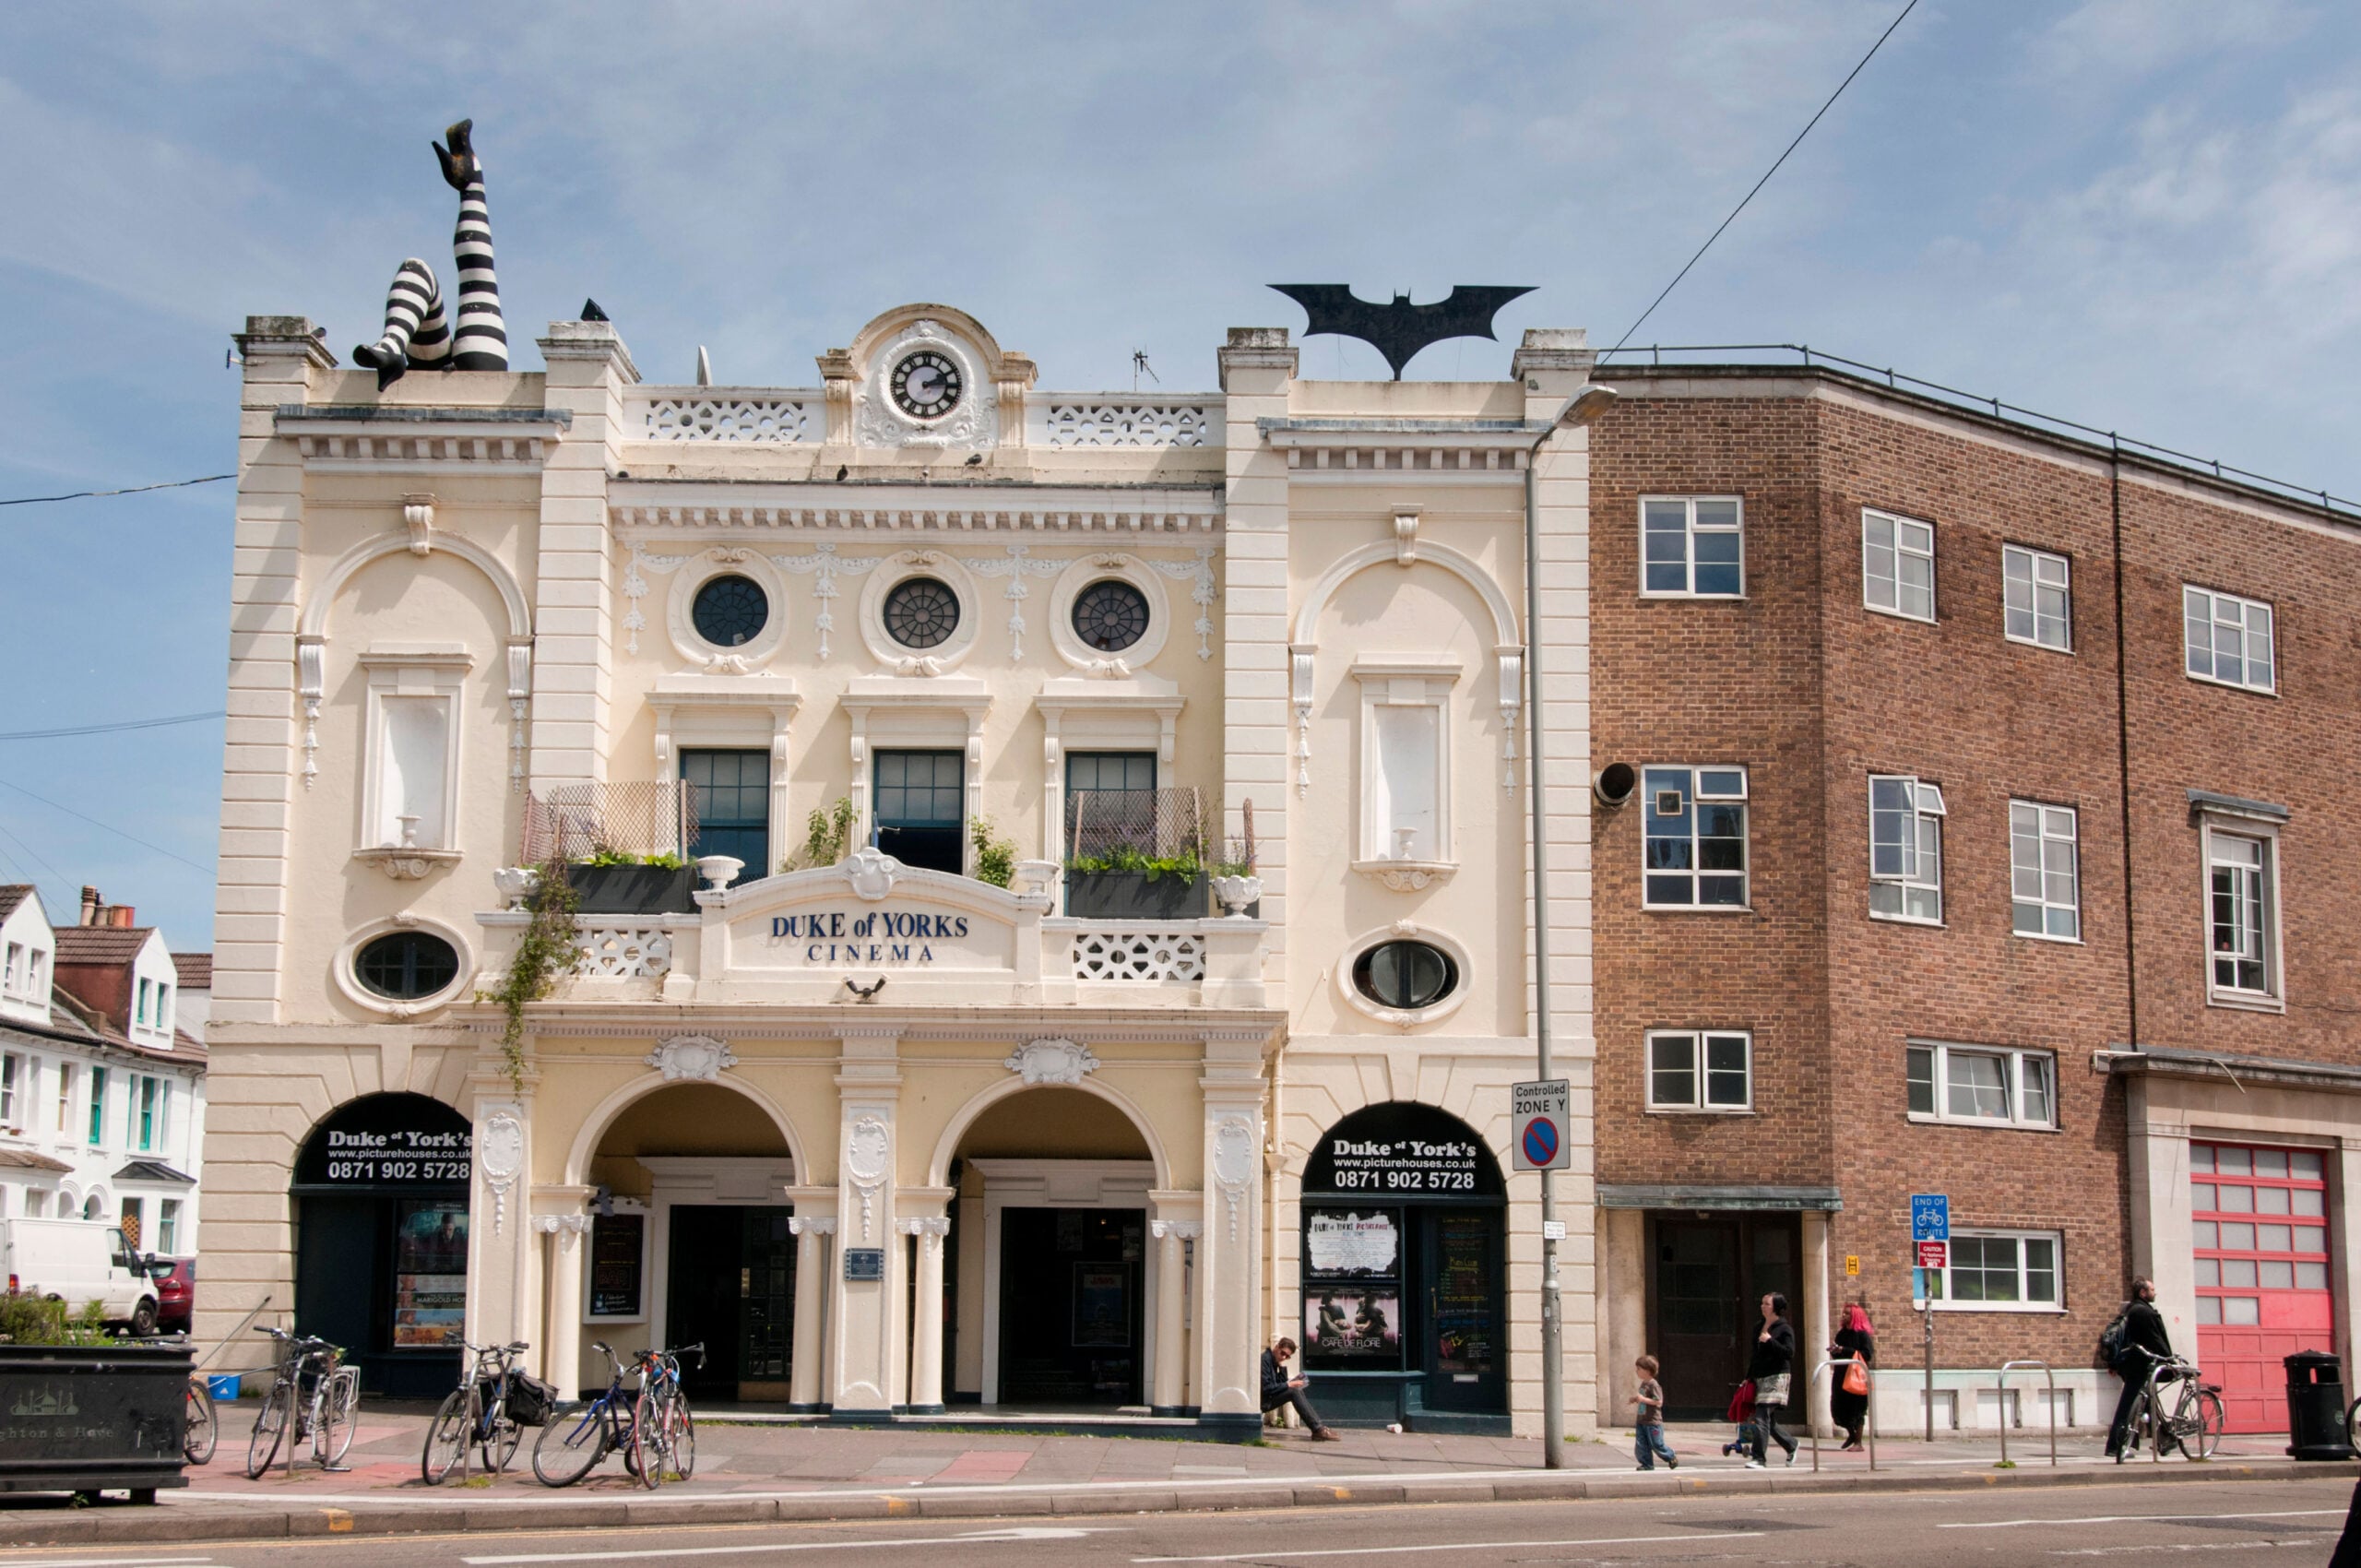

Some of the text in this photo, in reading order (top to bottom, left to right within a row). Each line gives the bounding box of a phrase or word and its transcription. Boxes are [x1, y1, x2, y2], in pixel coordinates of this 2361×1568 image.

[772, 911, 968, 939] DUKE of YORKS
[808, 944, 933, 962] CINEMA
[1516, 1084, 1565, 1097] Controlled
[1516, 1099, 1565, 1114] ZONE Y
[328, 1131, 472, 1146] Duke of York's
[328, 1148, 472, 1159] www.picturehouses.co.uk
[1334, 1140, 1476, 1157] Duke of York's
[328, 1162, 469, 1179] 0871 902 5728
[1334, 1158, 1476, 1169] www.picturehouses.co.uk
[1335, 1170, 1475, 1189] 0871 902 5728
[1934, 1198, 1944, 1206] OF
[1344, 1339, 1356, 1348] DE
[1357, 1339, 1382, 1348] FLORE
[0, 1426, 114, 1441] ghton & Hove
